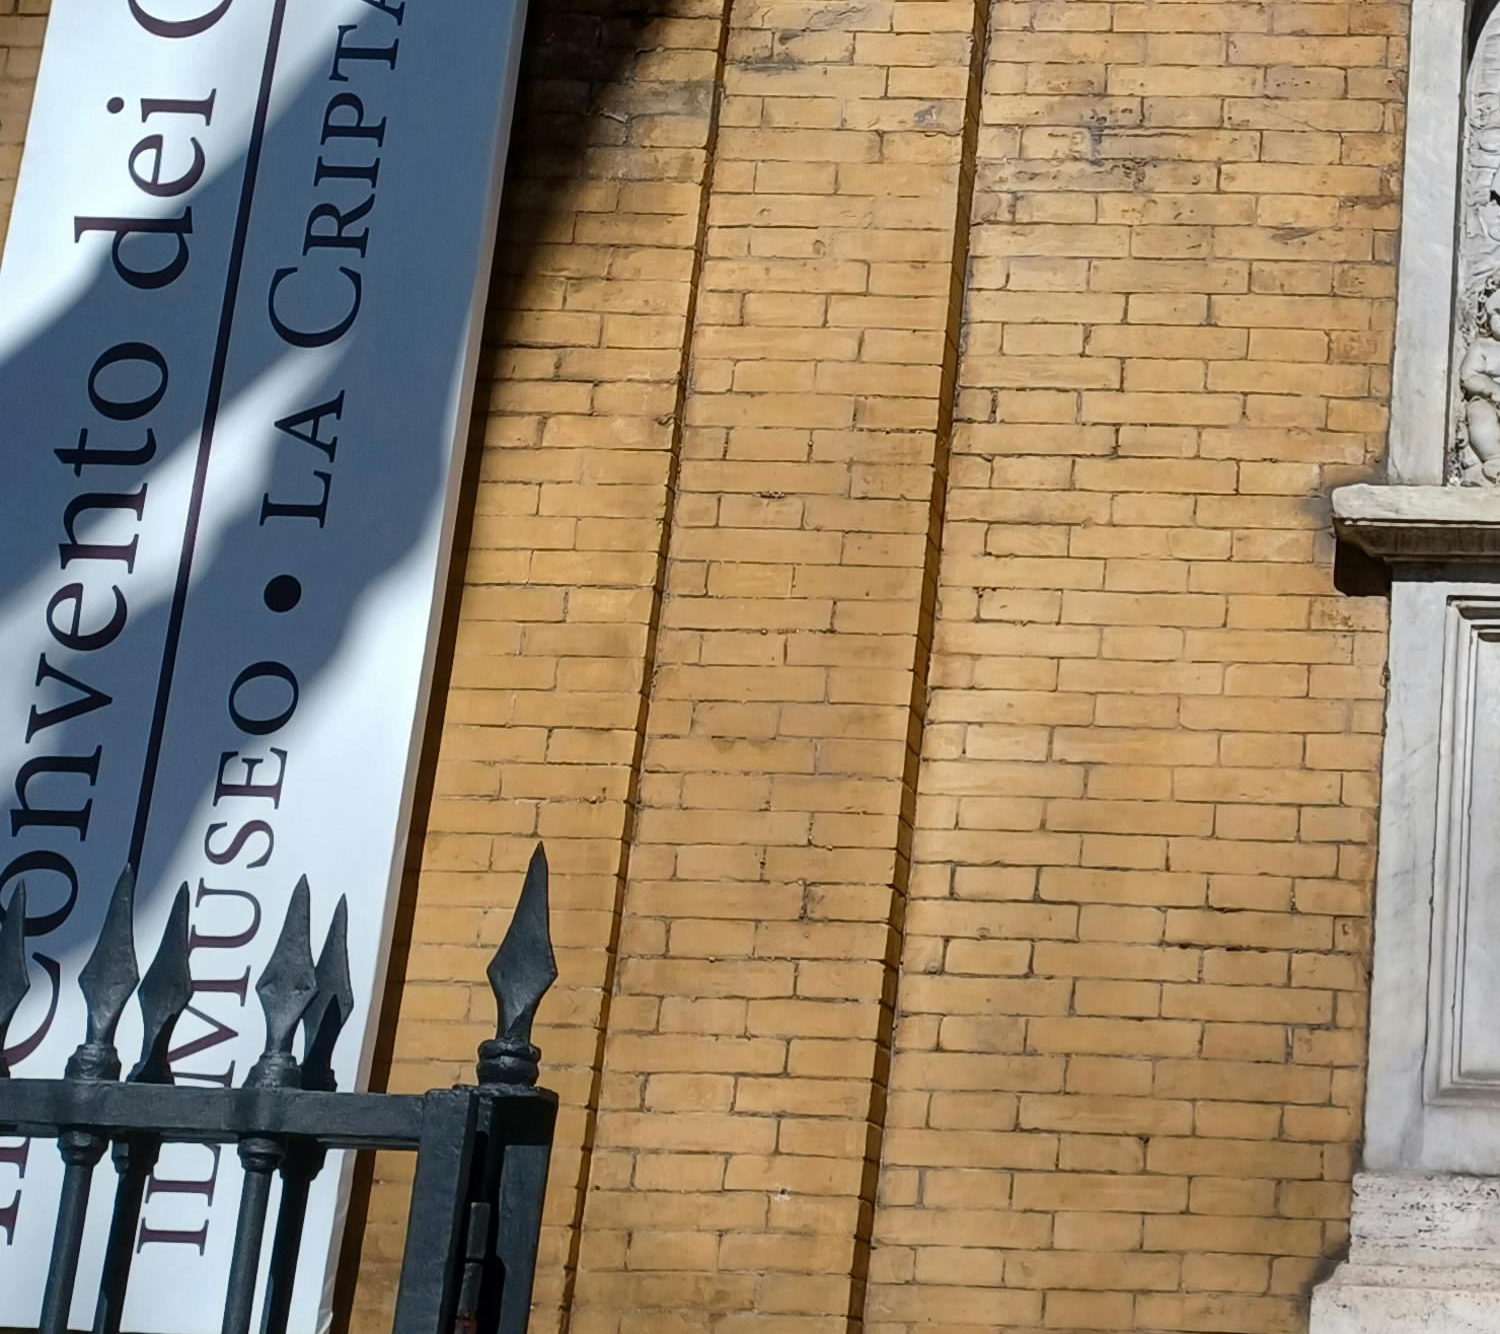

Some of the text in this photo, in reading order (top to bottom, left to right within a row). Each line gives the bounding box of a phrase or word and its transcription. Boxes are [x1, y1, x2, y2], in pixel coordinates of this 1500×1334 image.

[74, 85, 217, 290] dei
[167, 657, 300, 1089] MUSEO
[259, 389, 346, 528] LA
